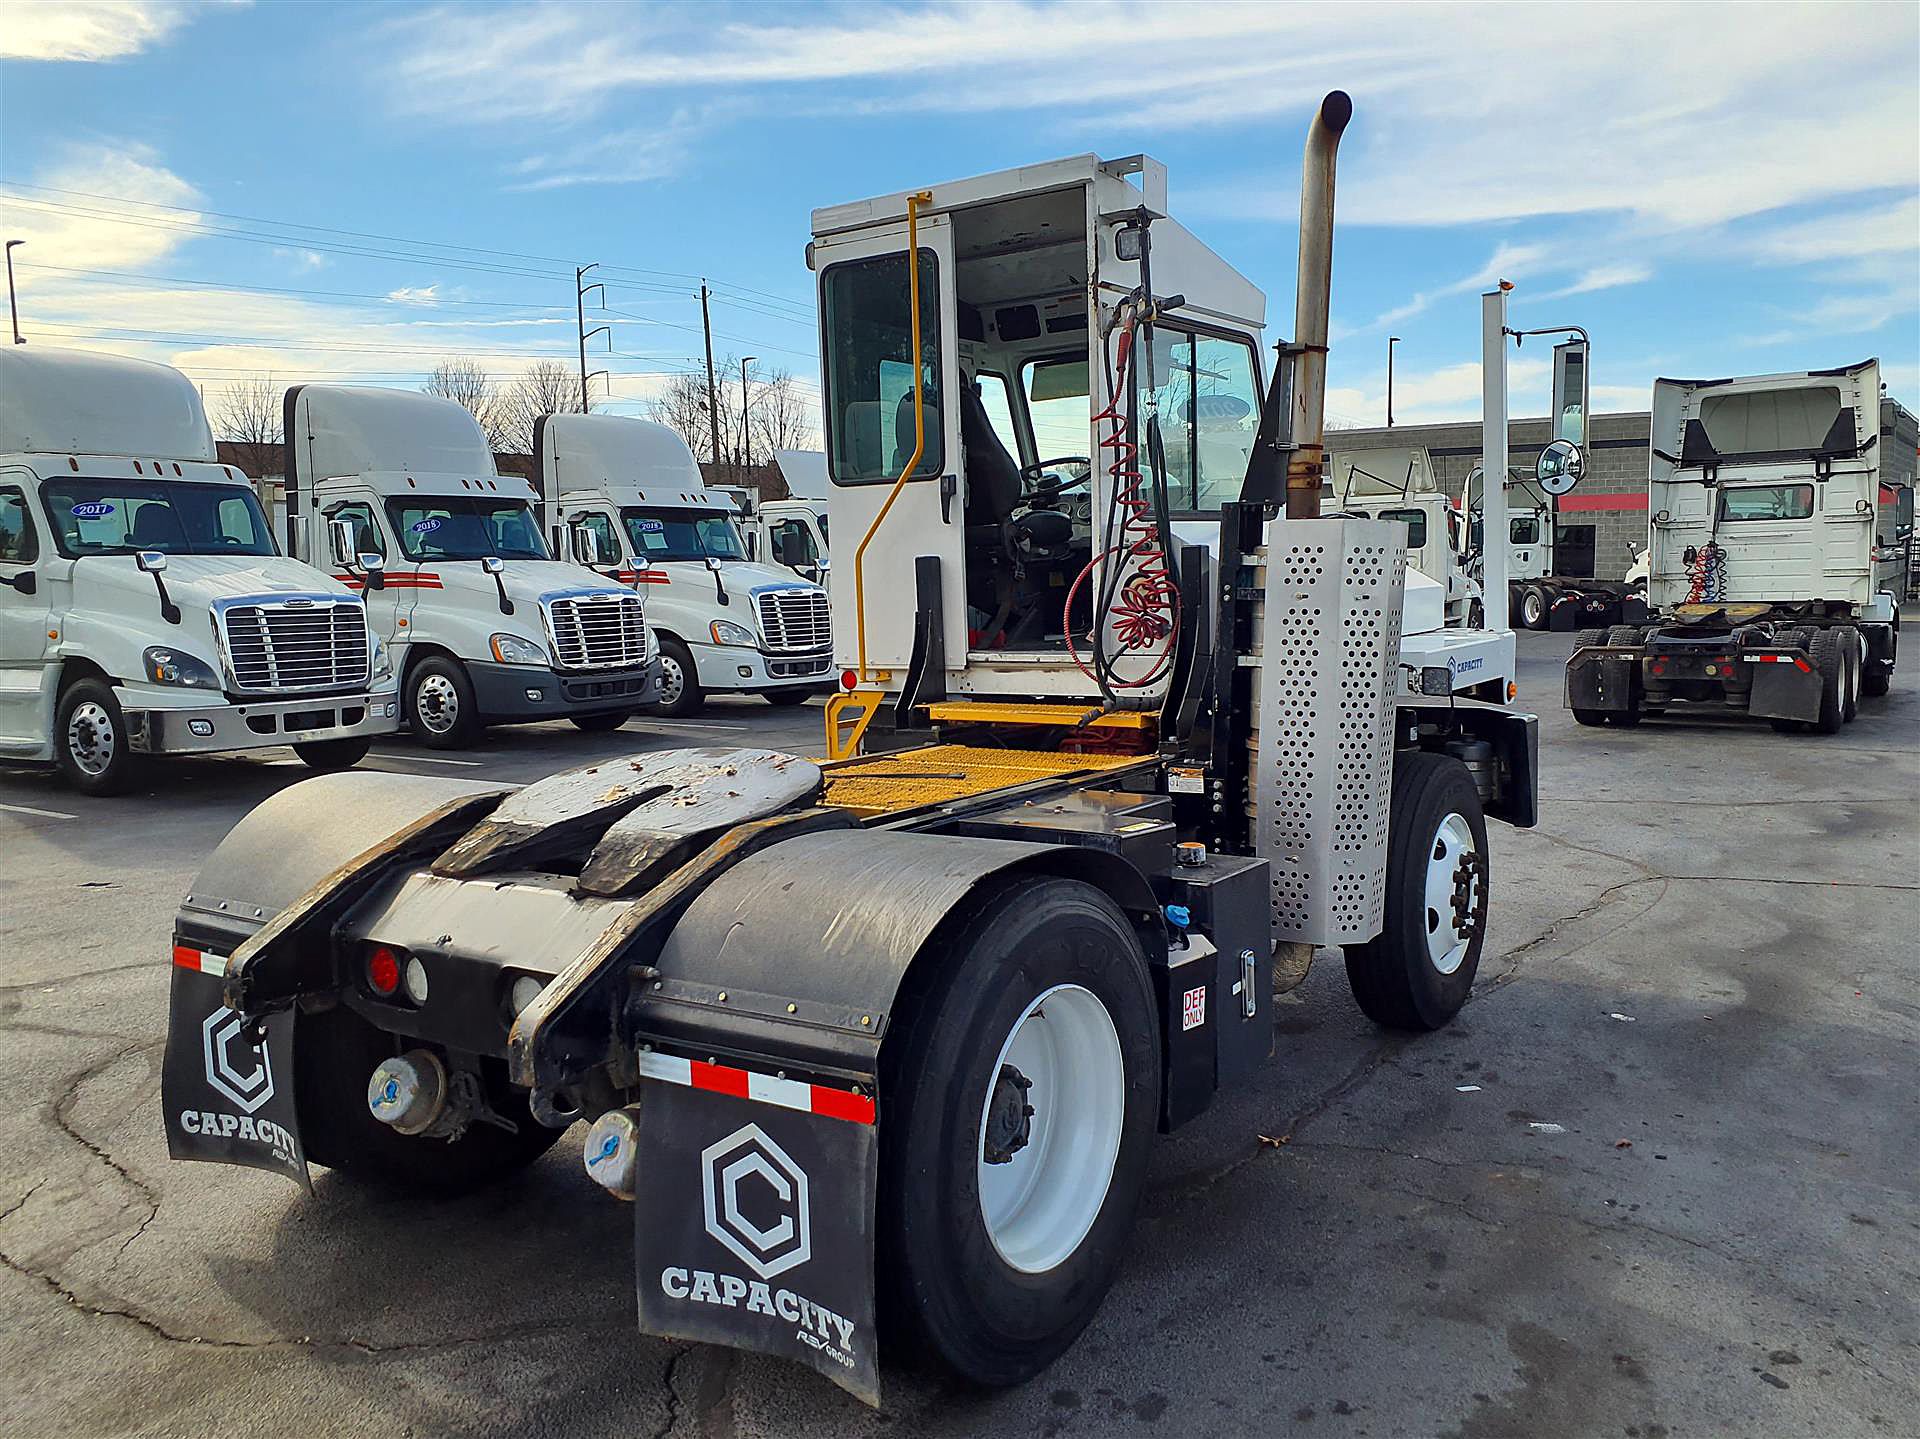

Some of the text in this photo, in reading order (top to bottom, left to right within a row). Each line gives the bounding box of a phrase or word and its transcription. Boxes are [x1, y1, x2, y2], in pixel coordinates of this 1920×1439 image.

[79, 504, 108, 515] 2017
[416, 519, 437, 532] 2018
[1457, 657, 1484, 673] CAPACITY
[1184, 987, 1205, 1012] DEF
[1184, 1007, 1204, 1027] ONLY
[180, 1109, 297, 1159] CAPACITY
[661, 1266, 856, 1352] CAPACITY
[796, 1330, 856, 1369] REV GROUP
